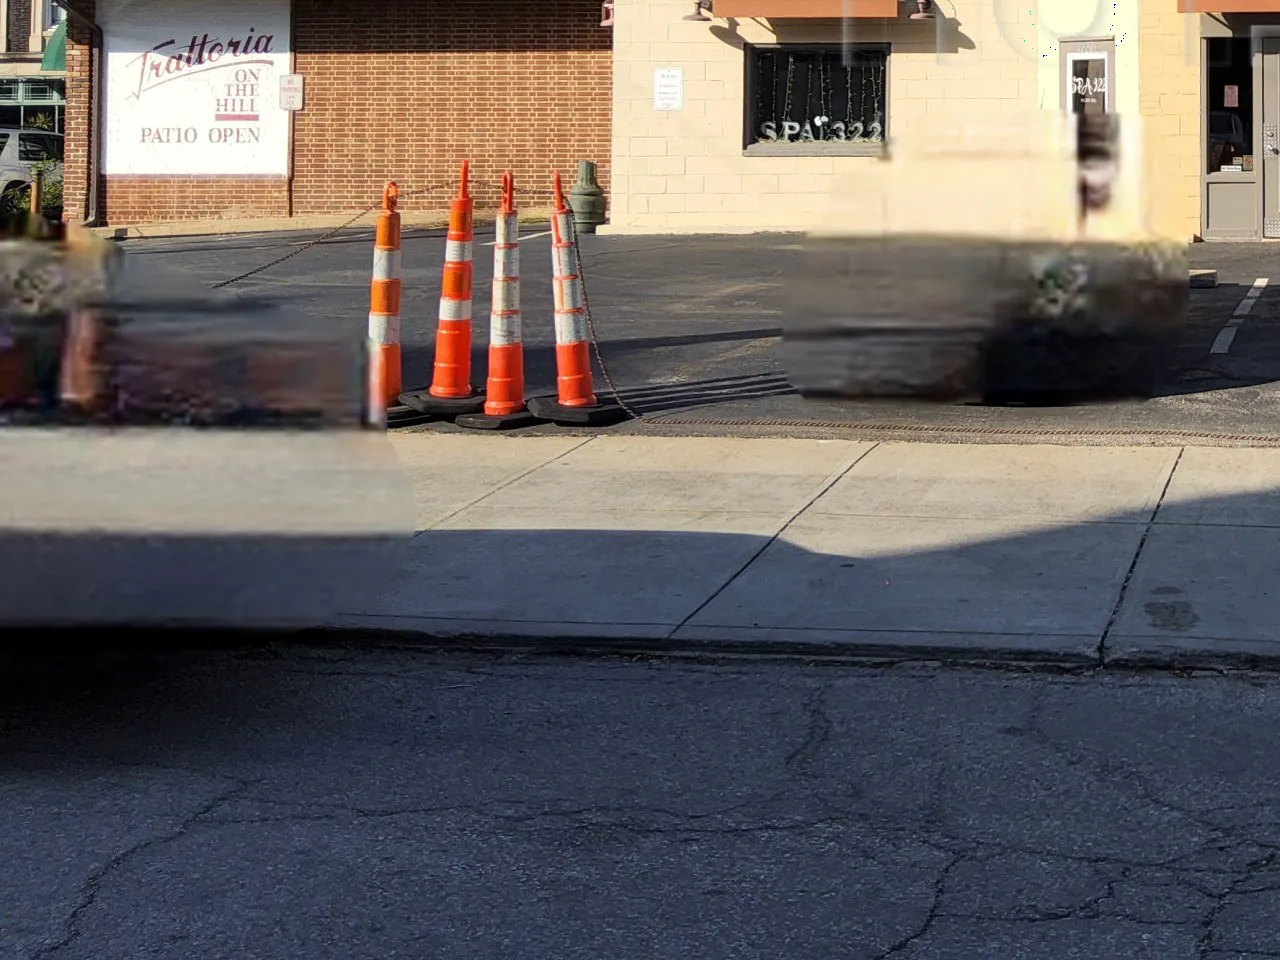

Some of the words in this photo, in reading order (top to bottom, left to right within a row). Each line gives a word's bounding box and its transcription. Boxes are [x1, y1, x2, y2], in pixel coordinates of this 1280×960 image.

[124, 27, 274, 100] Trattoria
[234, 69, 261, 83] ON
[224, 84, 260, 97] THE
[215, 98, 259, 112] HILL
[140, 127, 198, 144] PATIO
[208, 127, 261, 144] OPEN
[760, 121, 815, 141] SPA
[829, 120, 882, 141] 322
